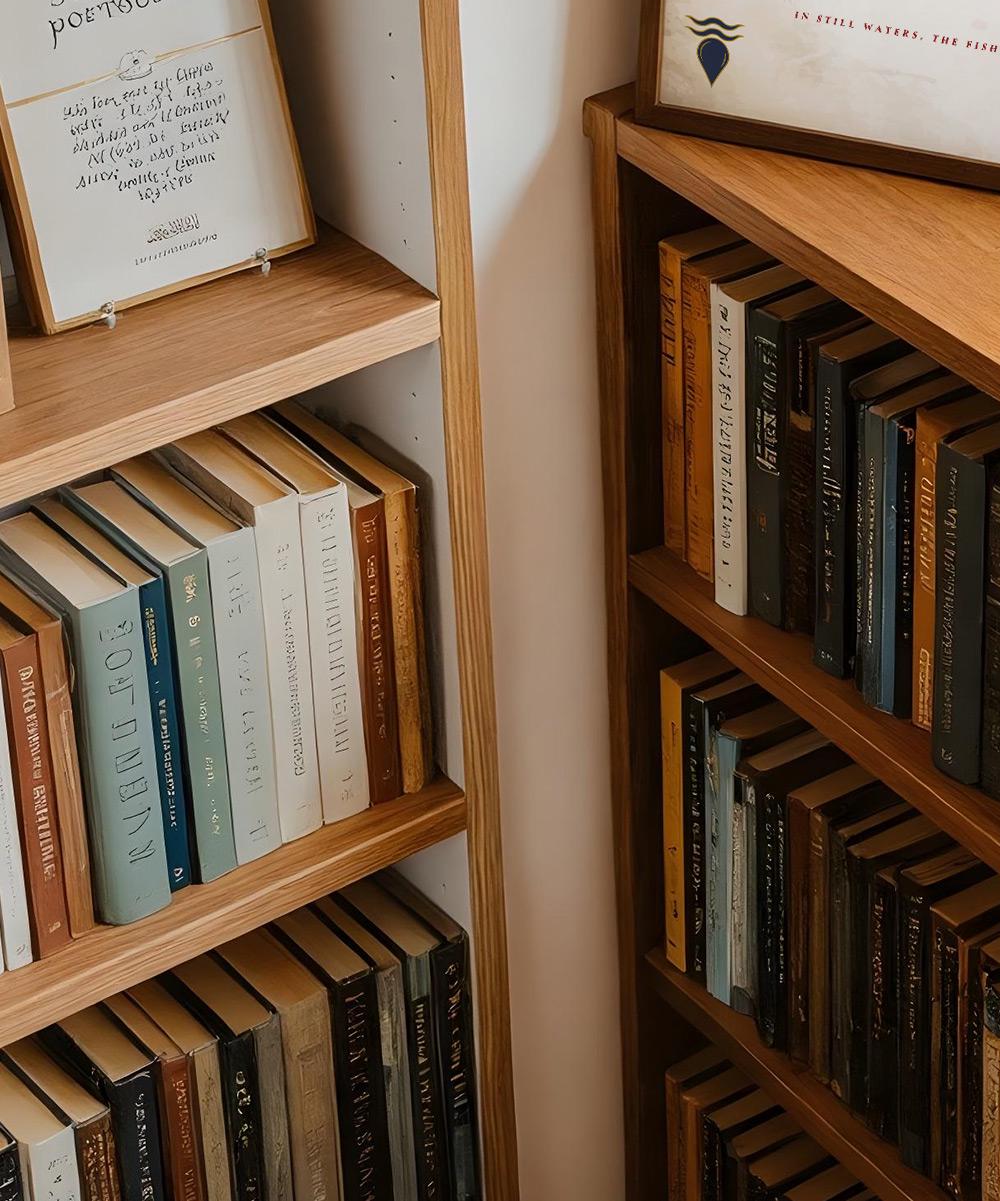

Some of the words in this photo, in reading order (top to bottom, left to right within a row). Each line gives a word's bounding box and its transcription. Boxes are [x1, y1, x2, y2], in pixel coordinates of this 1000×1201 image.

[793, 11, 809, 20] IN
[816, 14, 855, 29] STILL
[932, 33, 959, 47] THE
[965, 40, 998, 53] FISH
